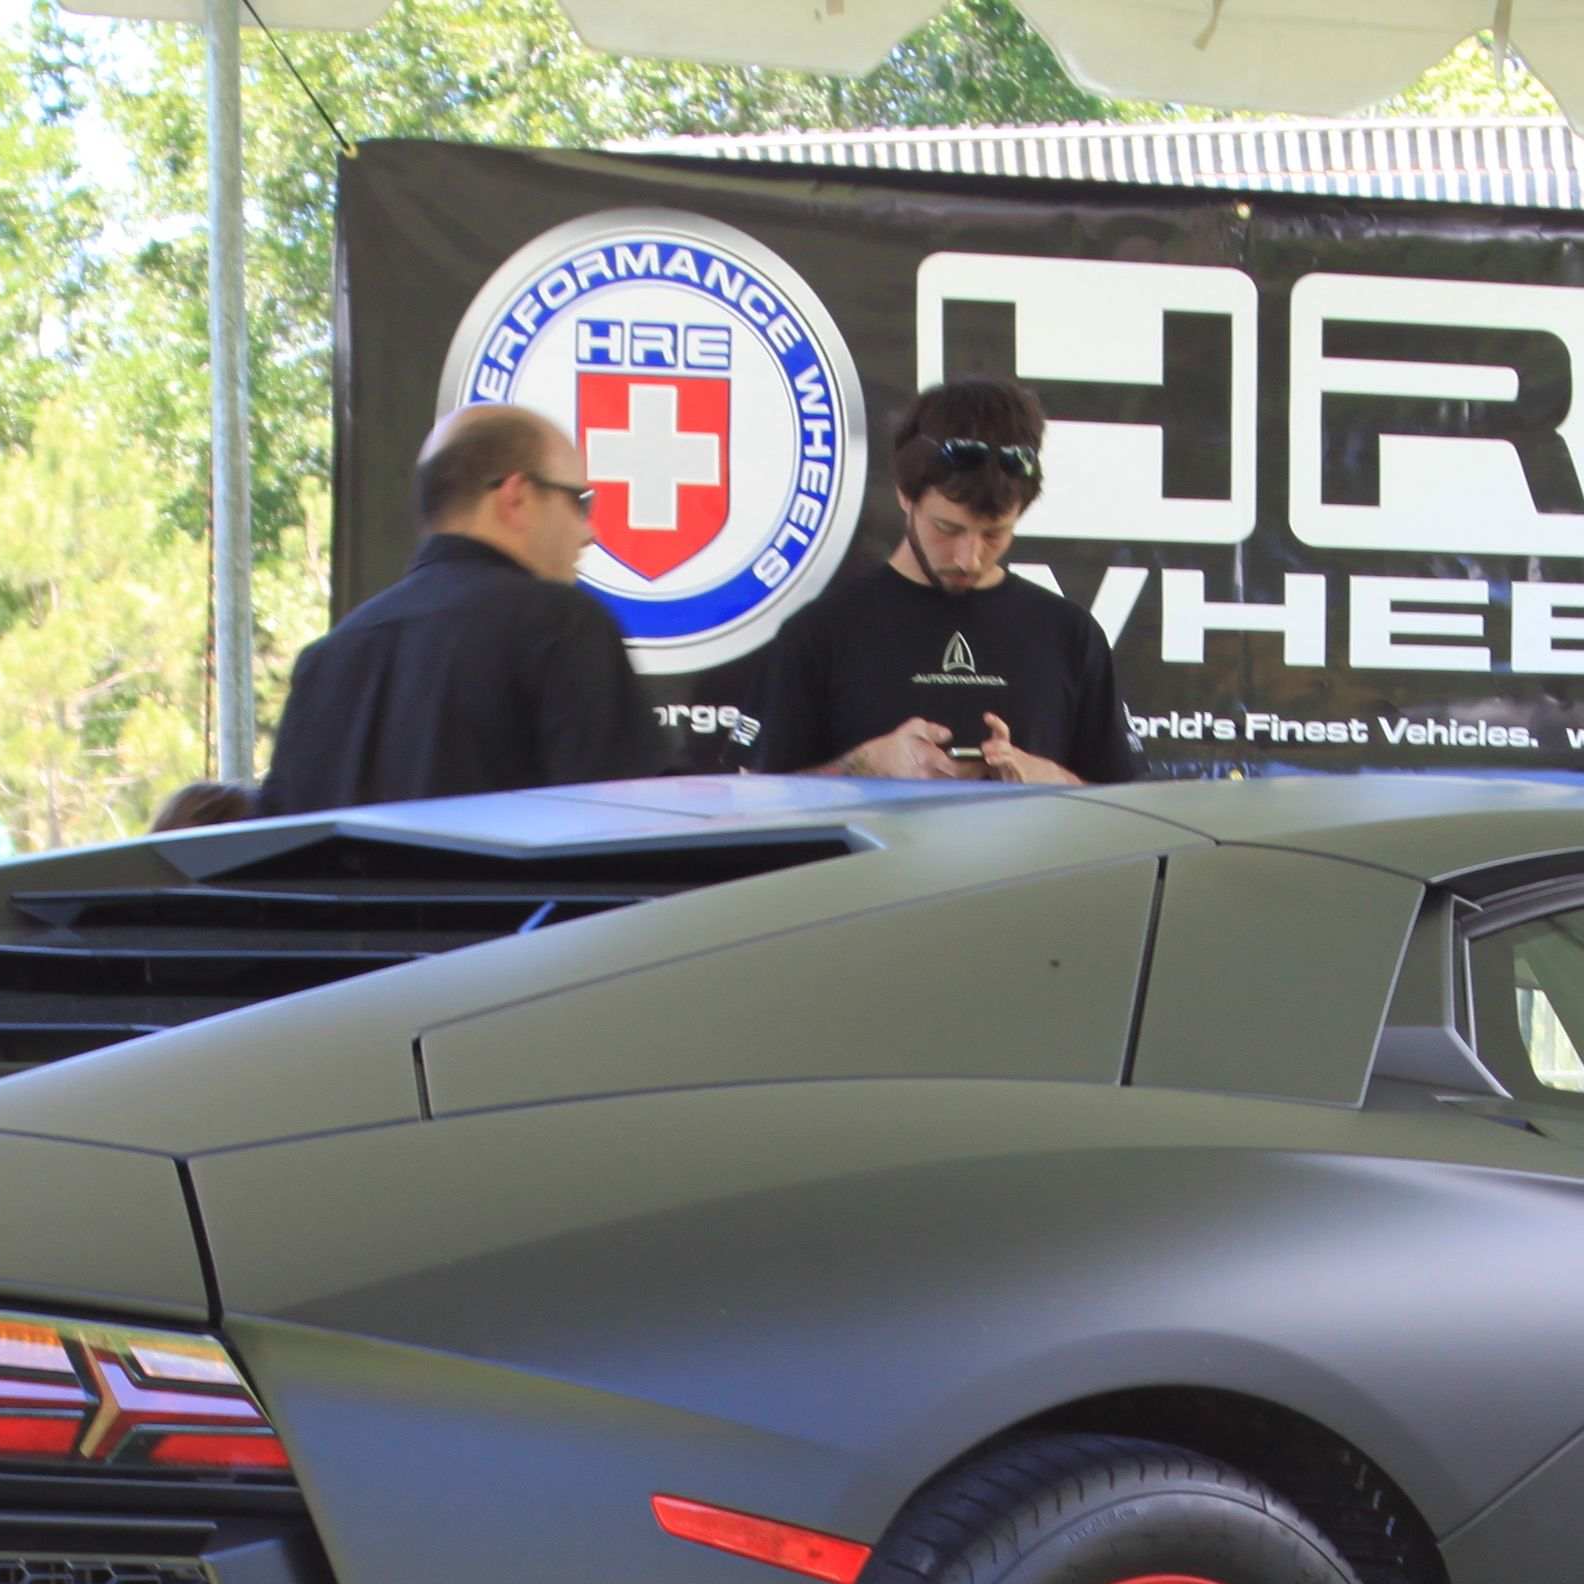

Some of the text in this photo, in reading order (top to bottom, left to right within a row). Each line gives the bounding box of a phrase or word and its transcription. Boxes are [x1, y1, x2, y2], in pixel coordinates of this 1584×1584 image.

[576, 319, 732, 370] HRE
[476, 243, 832, 590] ERFORMANCE WHEELS
[1122, 699, 1236, 740] orld's
[1244, 712, 1369, 743] Finest
[1378, 716, 1539, 747] Vehicles.
